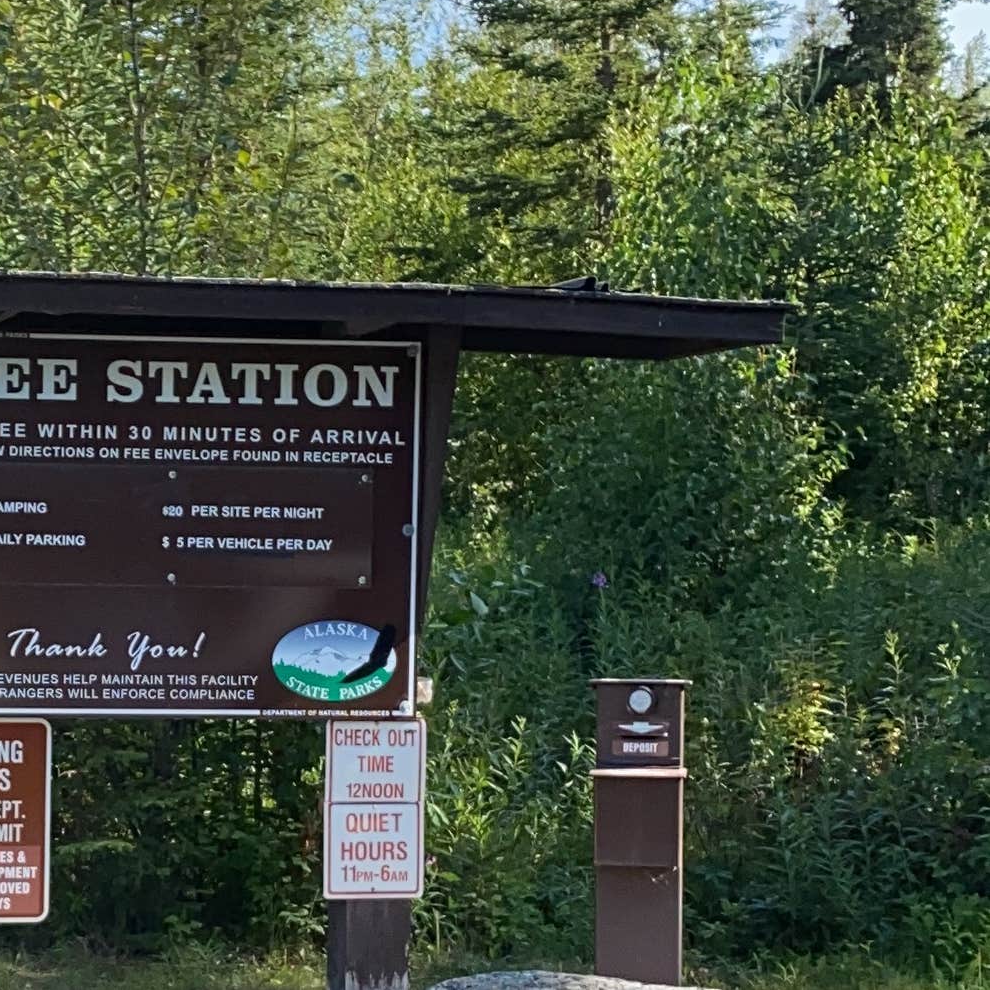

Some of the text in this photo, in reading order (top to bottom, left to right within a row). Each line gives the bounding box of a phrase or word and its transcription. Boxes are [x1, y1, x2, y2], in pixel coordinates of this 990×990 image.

[106, 360, 399, 408] STATION
[38, 424, 118, 439] WITHIN
[128, 426, 152, 440] 30
[163, 426, 261, 443] MINUTES
[272, 428, 301, 443] OF
[310, 429, 406, 446] ARRIVAL
[10, 446, 94, 458] DIRECTIONS
[99, 448, 120, 459] ON
[124, 448, 150, 459] FEE
[155, 448, 228, 460] ENVELOPE
[233, 450, 281, 461] FOUND
[286, 451, 299, 462] IN
[304, 452, 393, 464] RECEPTACLE
[162, 505, 324, 519] $20 PER SITE PER NIGHT
[26, 534, 86, 546] PARKING
[188, 537, 214, 548] PER
[217, 538, 273, 550] VEHICLE
[276, 538, 304, 550] PER
[306, 540, 333, 551] DAY
[303, 623, 368, 641] ALASKA
[8, 628, 205, 671] Thank You!
[63, 674, 97, 685] HELP
[102, 674, 163, 686] MAINTAIN
[167, 675, 197, 686] THIS
[202, 675, 258, 687] FACILITY
[286, 676, 383, 700] STATE PARKS
[68, 688, 98, 700] WILL
[102, 688, 165, 700] ENFORCE
[170, 689, 255, 701] COMPLIANCE
[334, 729, 417, 747] CHECK OUT
[623, 742, 659, 754] DEPOSIT
[357, 756, 394, 773] TIME
[346, 813, 403, 834] QUIET
[17, 851, 26, 863] &
[341, 841, 408, 861] HOURS
